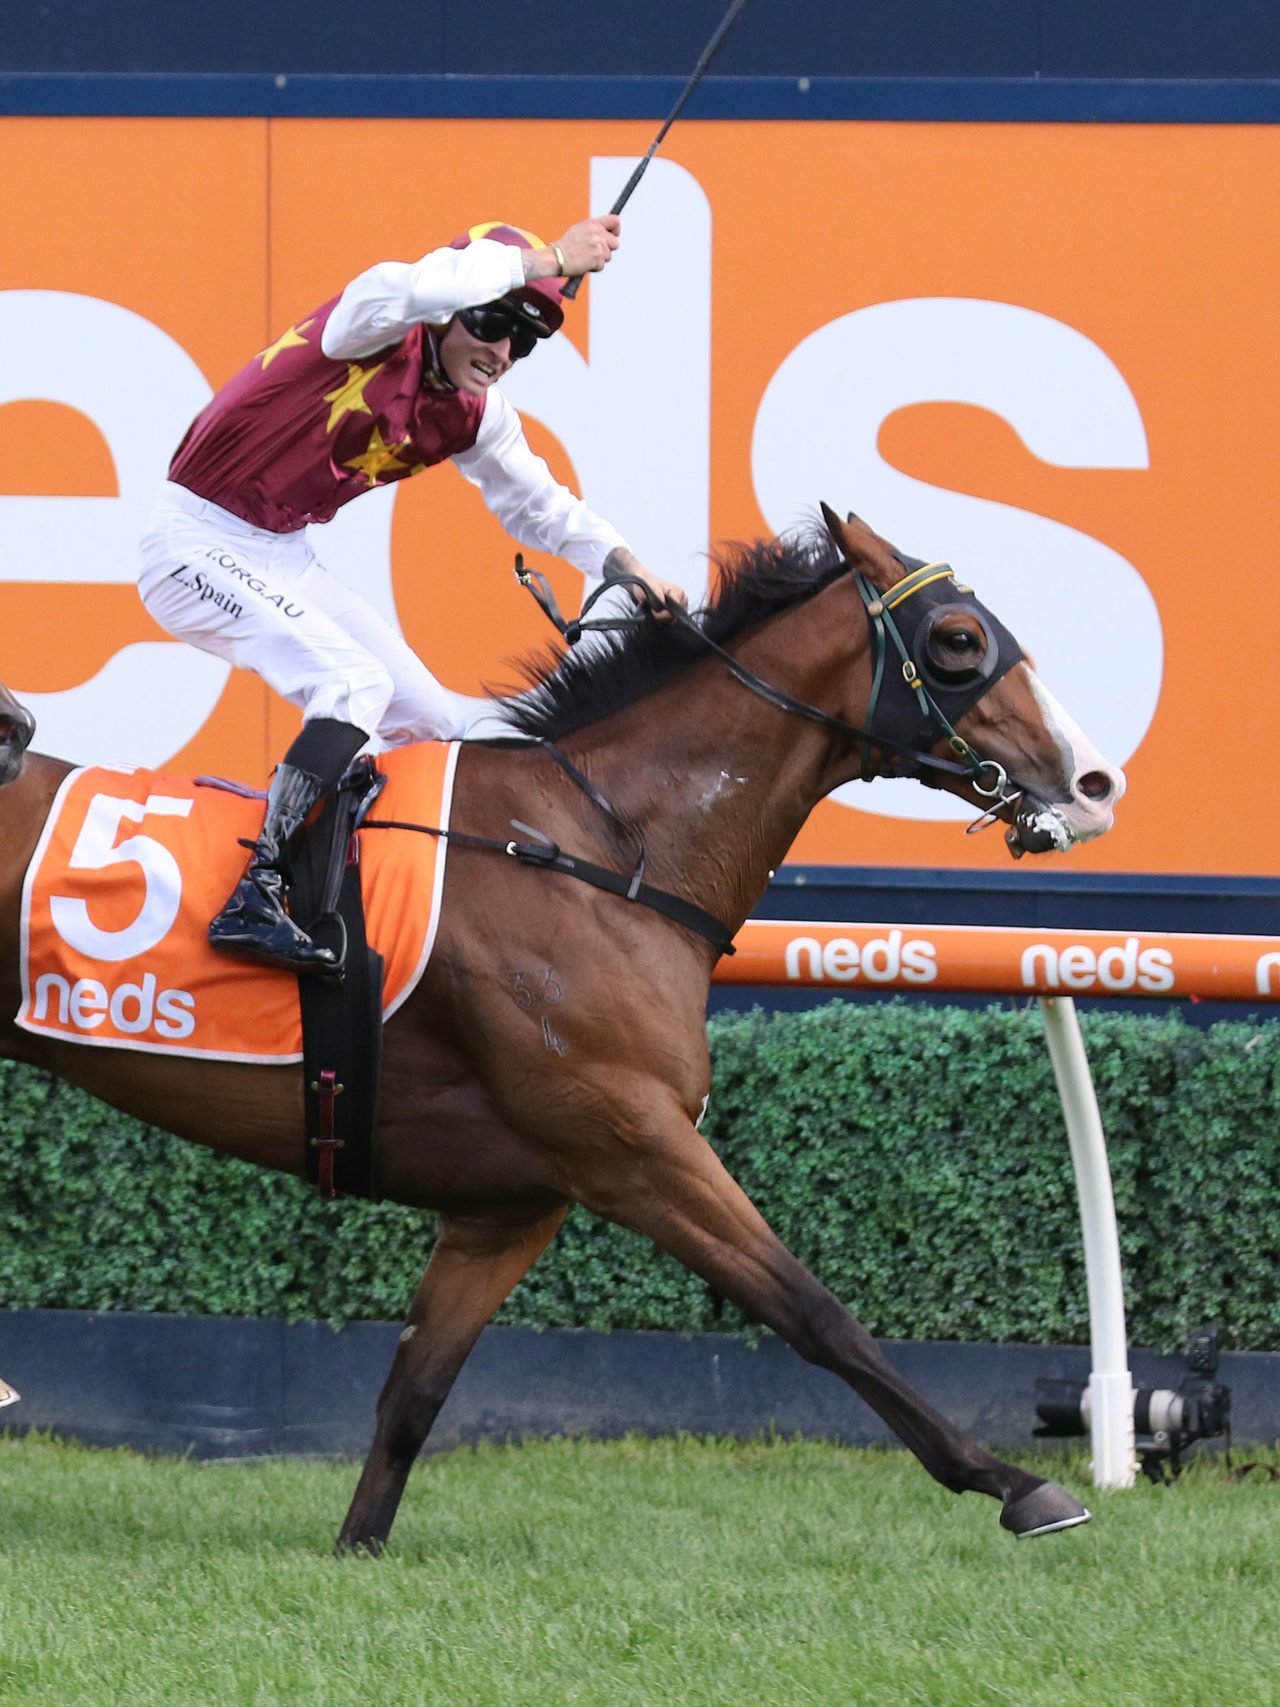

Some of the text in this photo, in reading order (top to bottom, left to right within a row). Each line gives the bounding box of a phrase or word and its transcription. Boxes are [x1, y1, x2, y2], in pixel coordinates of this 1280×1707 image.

[49, 792, 195, 961] 5
[785, 929, 938, 984] neds
[1021, 937, 1175, 991] neds
[32, 972, 196, 1039] neds
